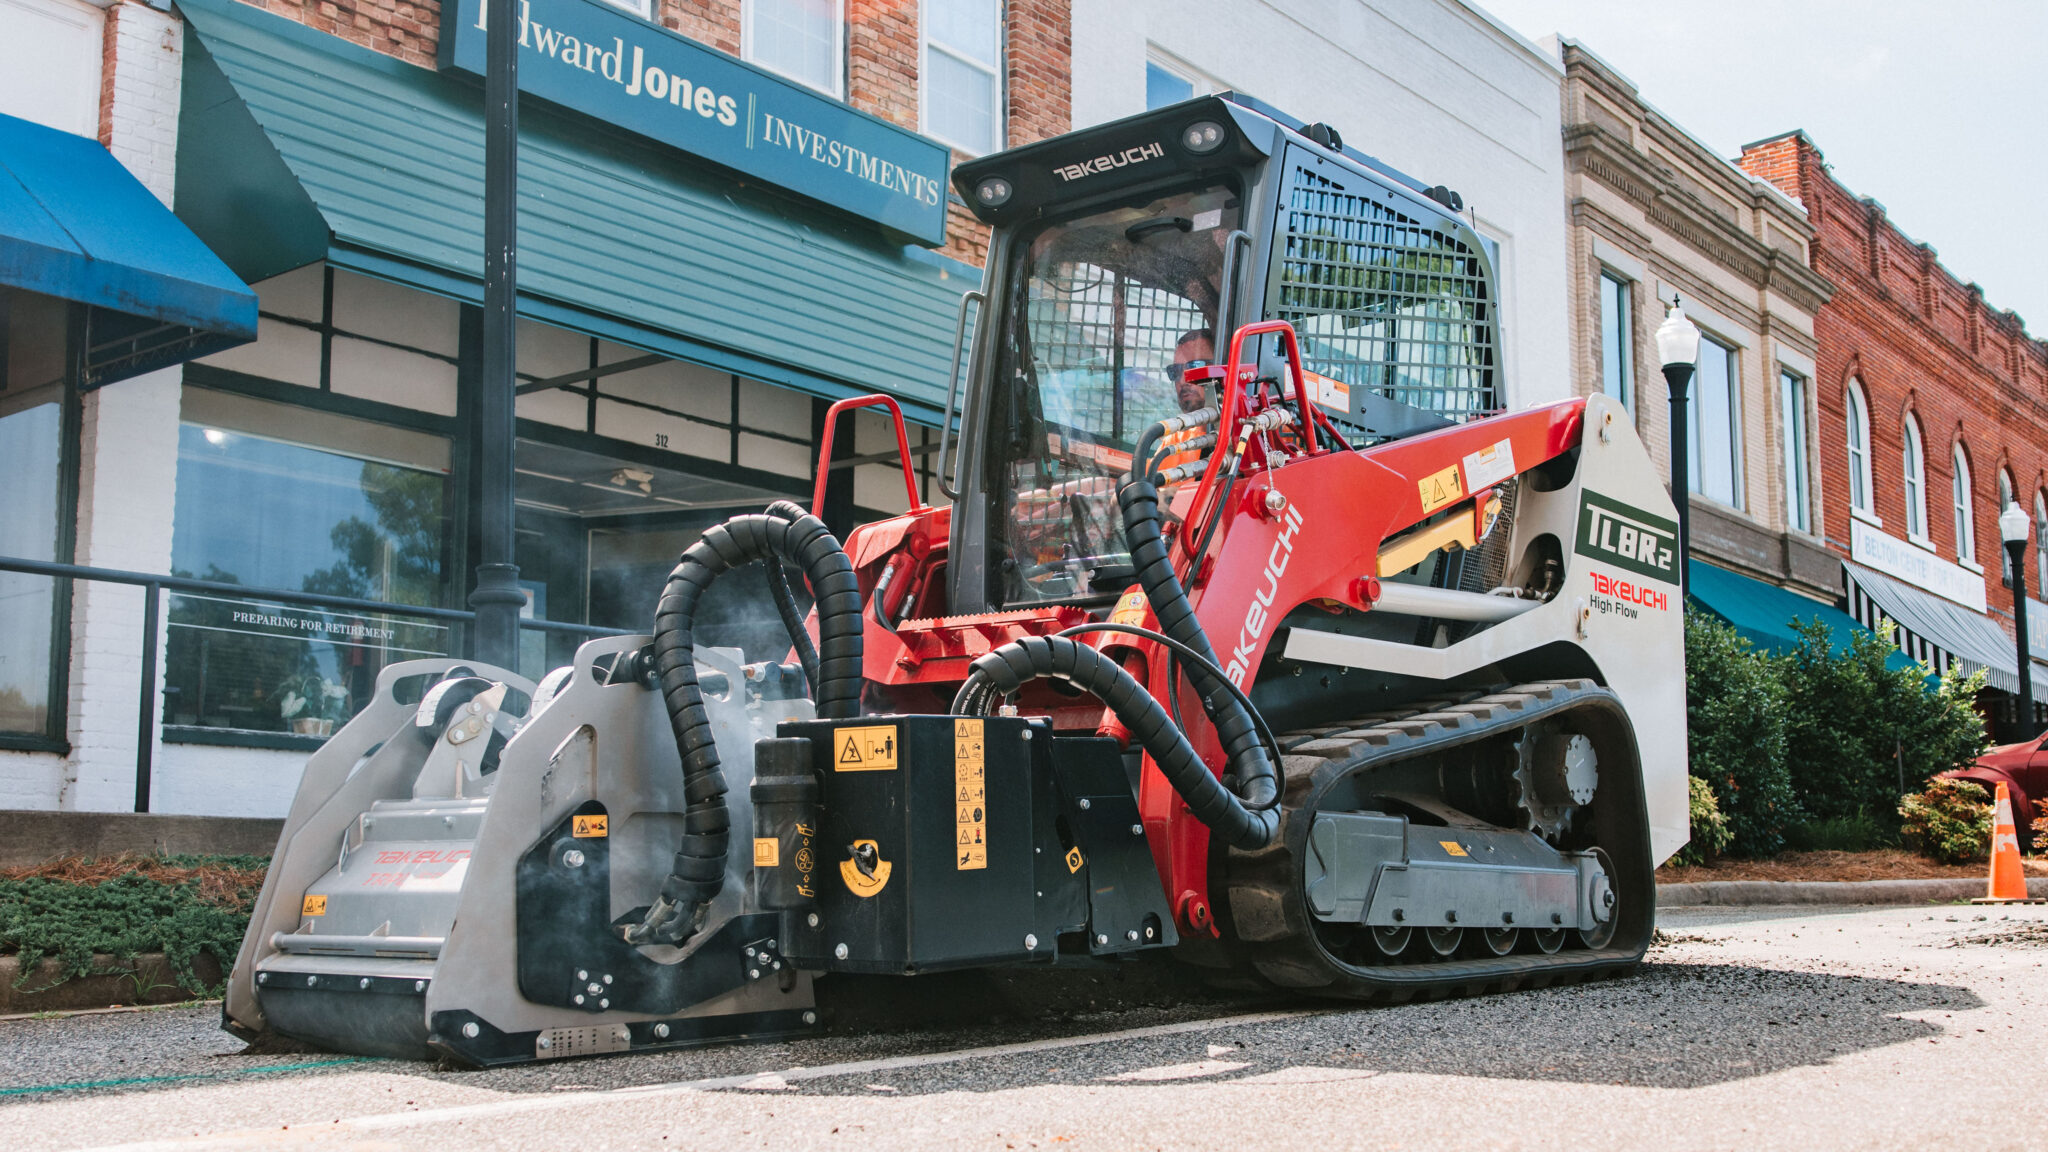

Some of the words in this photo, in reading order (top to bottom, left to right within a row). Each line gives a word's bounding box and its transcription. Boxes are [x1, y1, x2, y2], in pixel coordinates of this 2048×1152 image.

[763, 113, 939, 206] INVESTMENTS
[1053, 142, 1165, 182] TAKEUCHI
[655, 433, 669, 448] 312
[1864, 534, 1899, 566] BELTON
[1225, 503, 1304, 689] AKEUCHI
[1589, 572, 1667, 612] TAKEUCHI
[1590, 594, 1613, 613] High
[1615, 602, 1638, 619] Flow
[232, 611, 298, 629] PREPARING
[300, 619, 322, 632] FOR
[325, 622, 395, 640] RETIREMENT
